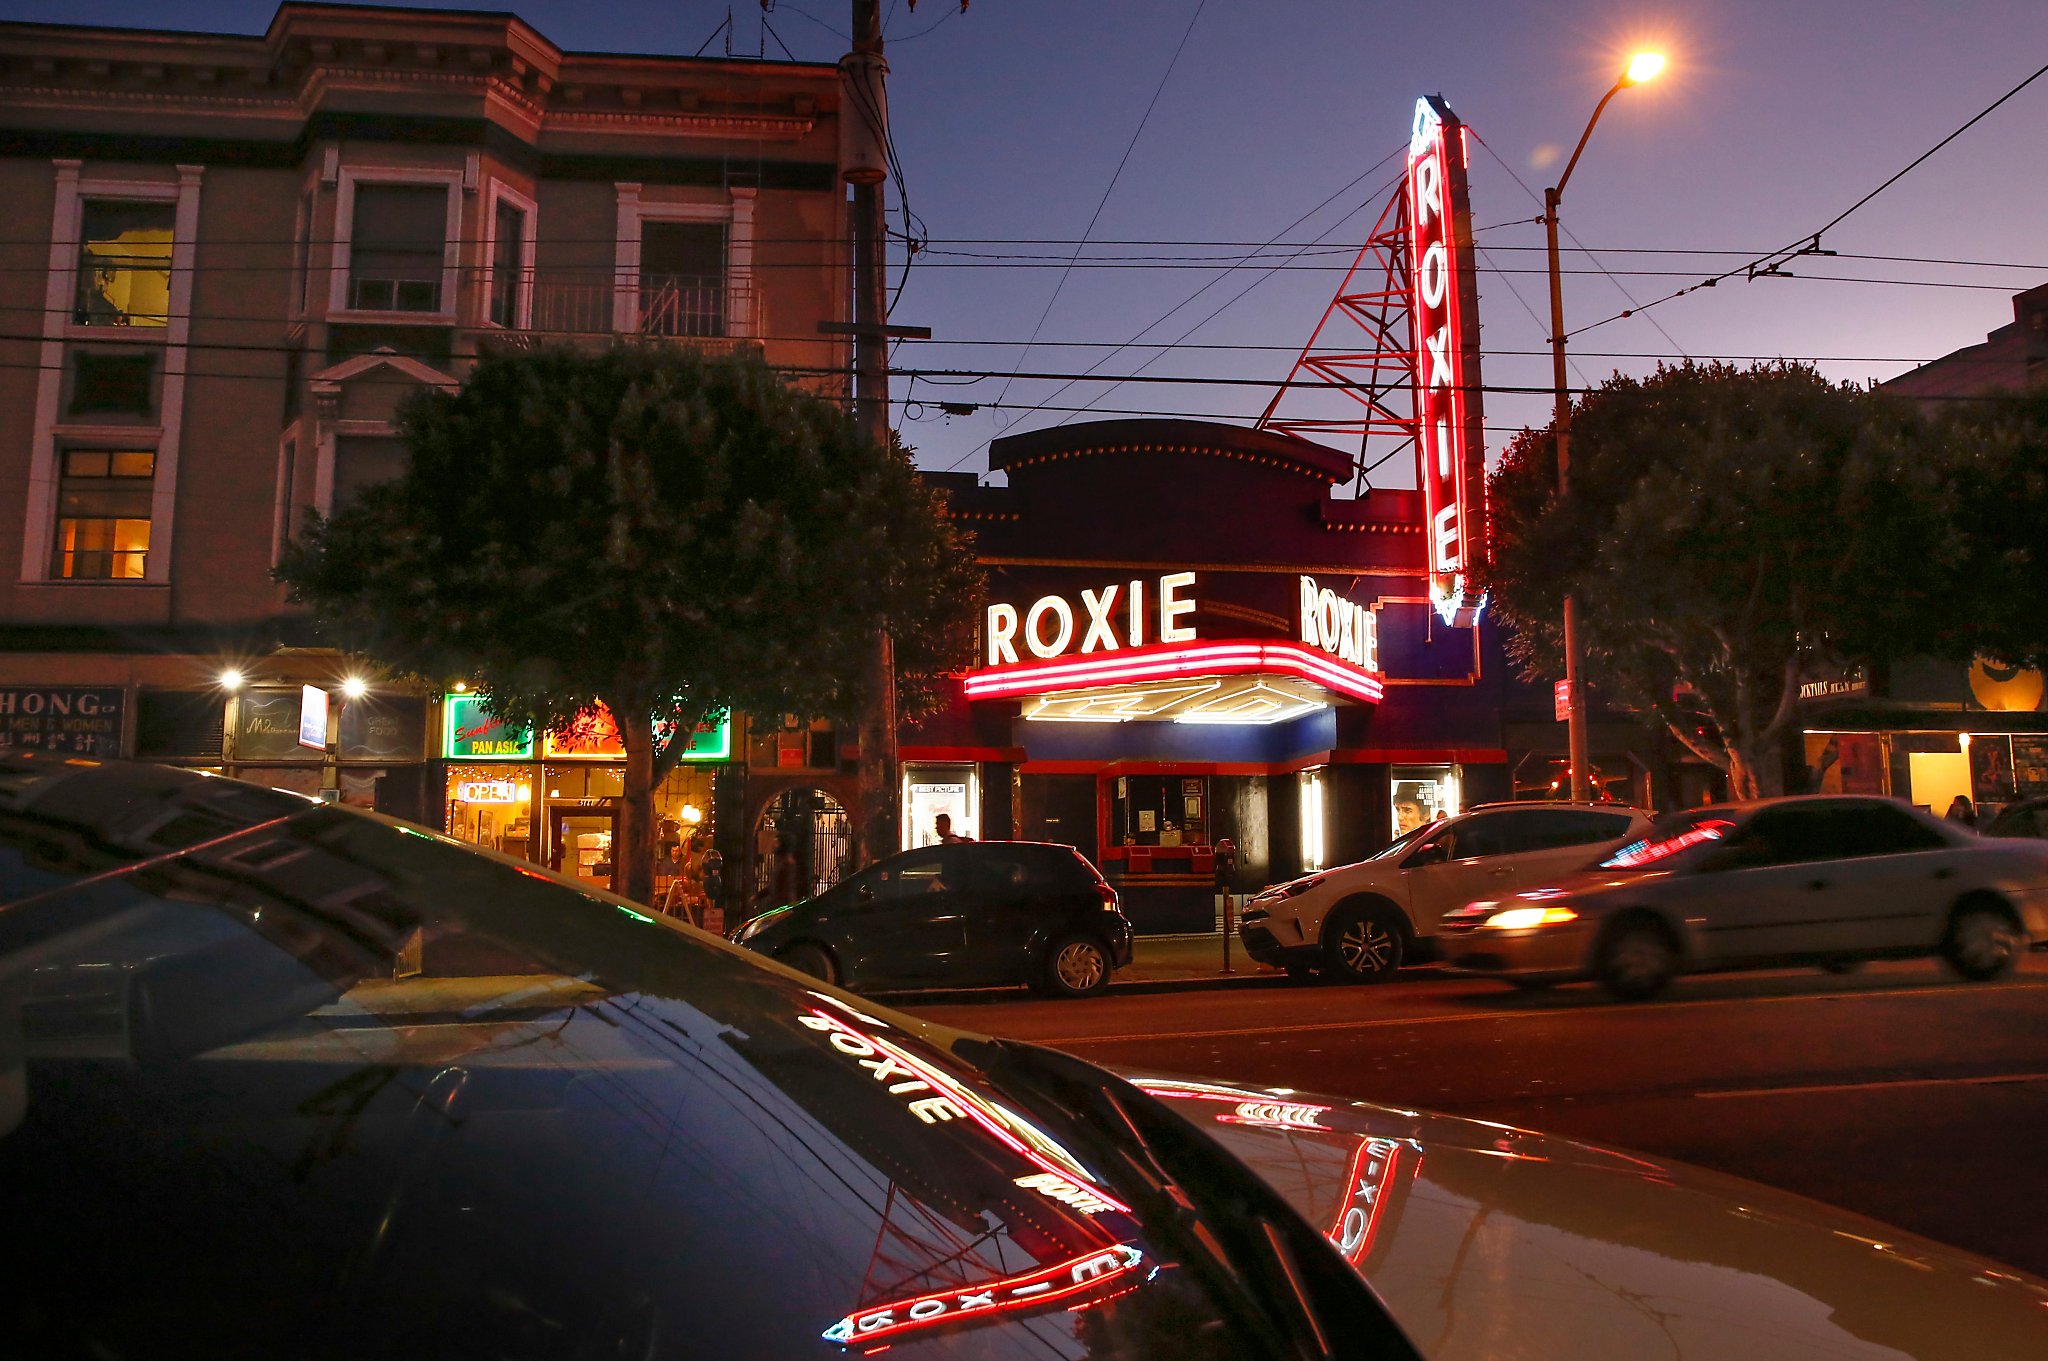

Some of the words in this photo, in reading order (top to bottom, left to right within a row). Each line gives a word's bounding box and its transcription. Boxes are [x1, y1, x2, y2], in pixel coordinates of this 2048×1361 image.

[1416, 153, 1460, 573] ROXIE
[987, 571, 1198, 666] ROXIE
[1300, 575, 1379, 673] ROXIE
[0, 693, 99, 715] HONG
[63, 719, 113, 732] WOMEN
[472, 740, 493, 755] PAN
[467, 785, 511, 801] OPEN
